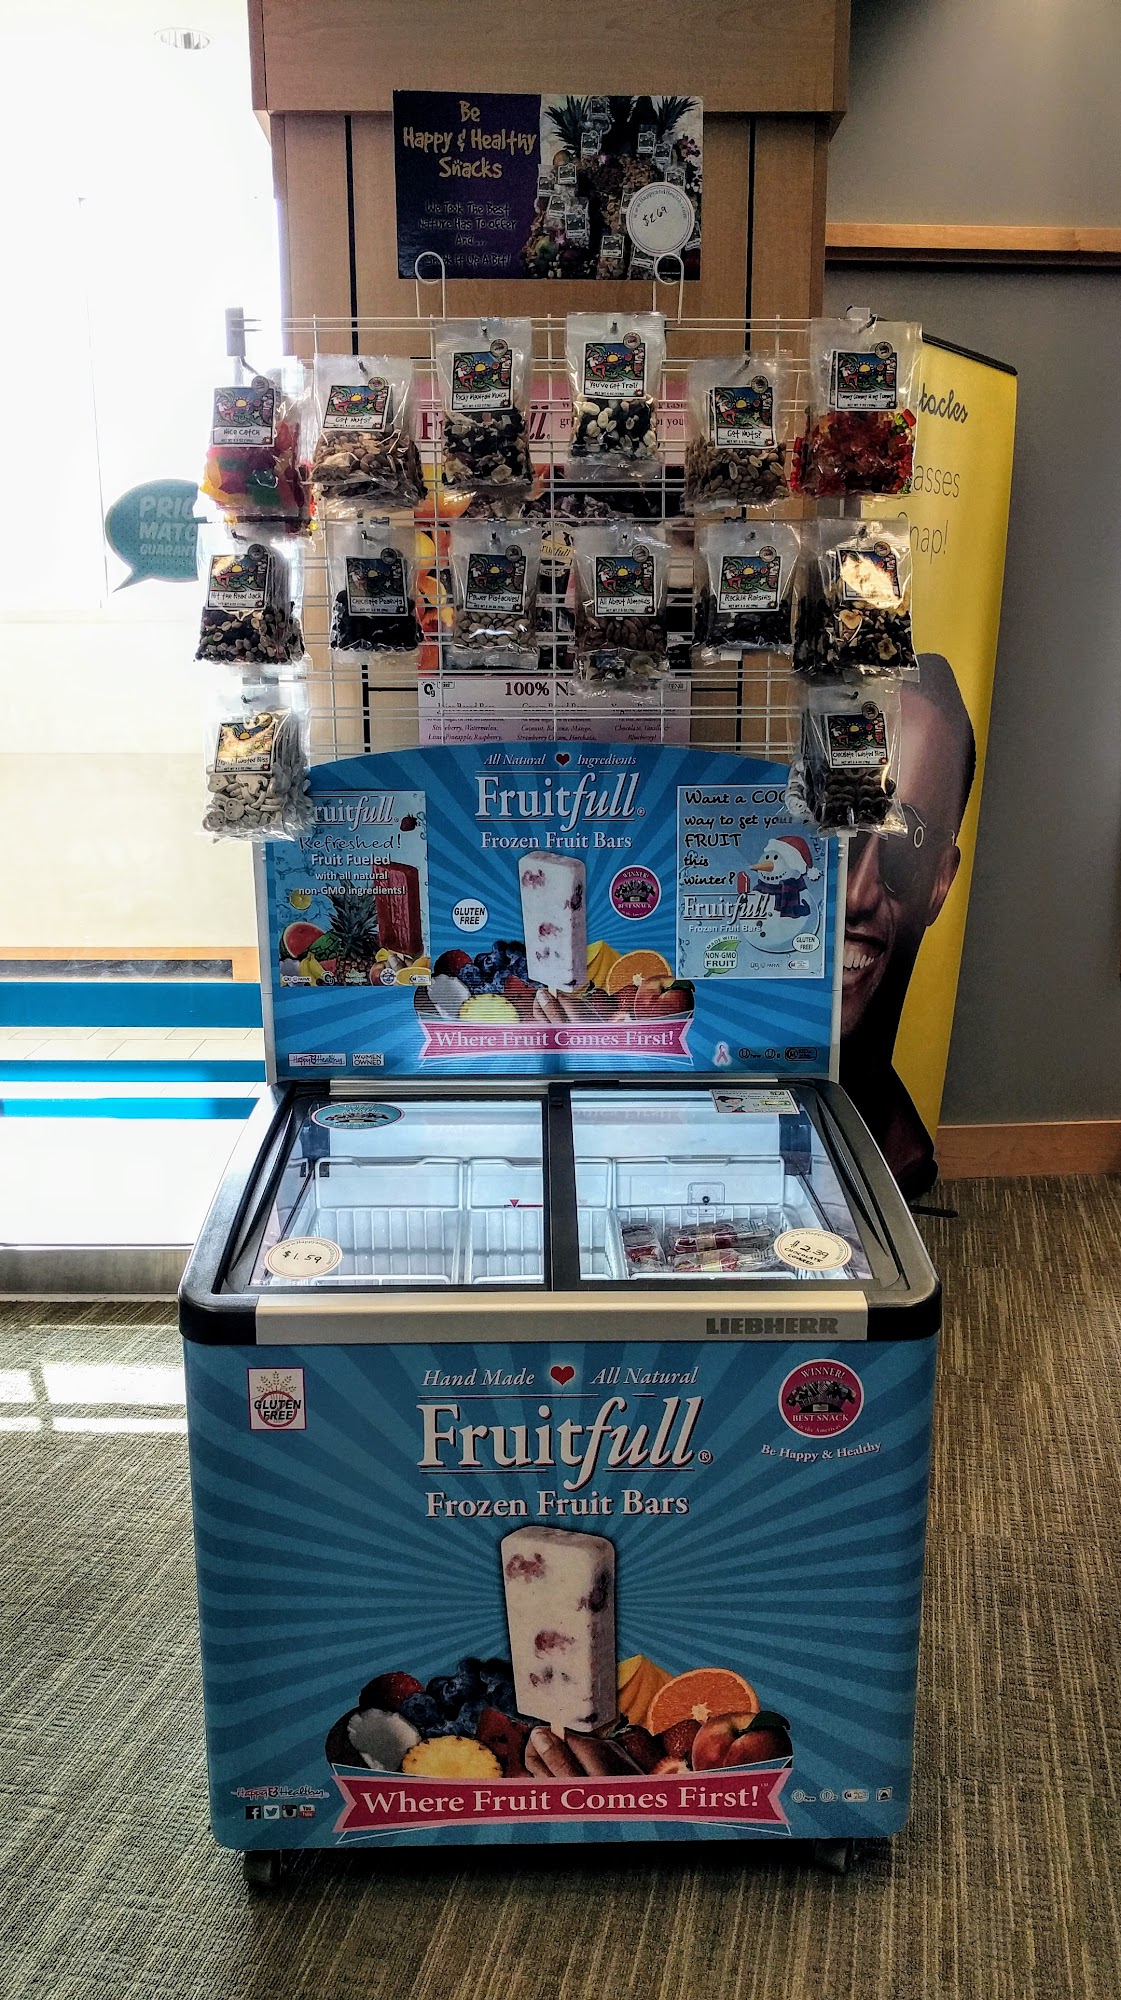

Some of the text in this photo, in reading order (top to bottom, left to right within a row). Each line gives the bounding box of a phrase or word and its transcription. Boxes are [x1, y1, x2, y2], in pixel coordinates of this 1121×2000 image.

[459, 100, 481, 122] Be
[403, 126, 537, 156] Happy & Healthy
[438, 156, 502, 178] Snacks
[444, 201, 463, 214] Took
[467, 201, 483, 214] The
[486, 202, 510, 217] Best
[455, 218, 472, 230] Has
[475, 217, 486, 230] To
[590, 381, 609, 389] You've
[610, 382, 621, 390] Got
[239, 429, 260, 437] Catch
[727, 429, 763, 440] Got Nuts?
[913, 465, 960, 498] asses
[139, 496, 196, 519] PRIC
[140, 521, 198, 541] MATC
[504, 681, 550, 697] 100%
[483, 754, 637, 768] All Natural Ingredients
[685, 790, 730, 804] Want
[735, 795, 747, 804] a
[314, 796, 395, 832] ruitfull
[684, 816, 715, 829] way
[720, 815, 734, 825] to
[740, 815, 758, 829] get
[299, 834, 402, 853] Refreshed!
[480, 832, 633, 849] Frozen Fruit Bars
[685, 834, 741, 848] FRUIT
[311, 853, 391, 867] Fruit Fueled
[684, 854, 709, 867] this
[315, 871, 388, 881] with all natural
[298, 886, 406, 897] non-GMO ingredients!
[454, 907, 486, 916] GLUTEN
[460, 917, 481, 925] FREE
[688, 925, 762, 933] Frozen Fruit Bars
[435, 1030, 674, 1048] Where Fruit Comes First!
[706, 1318, 838, 1334] LIEBHERR
[421, 1366, 700, 1387] Hand Made All Natural
[801, 1367, 845, 1379] WINNER!
[254, 1400, 301, 1410] GLUTEN
[263, 1410, 294, 1420] FREE
[817, 1414, 848, 1422] SNACK
[761, 1442, 881, 1462] Be Happy & Healthy
[425, 1489, 689, 1518] Frozen Fruit Bars
[360, 1785, 759, 1814] Where Fruit Comes First!
